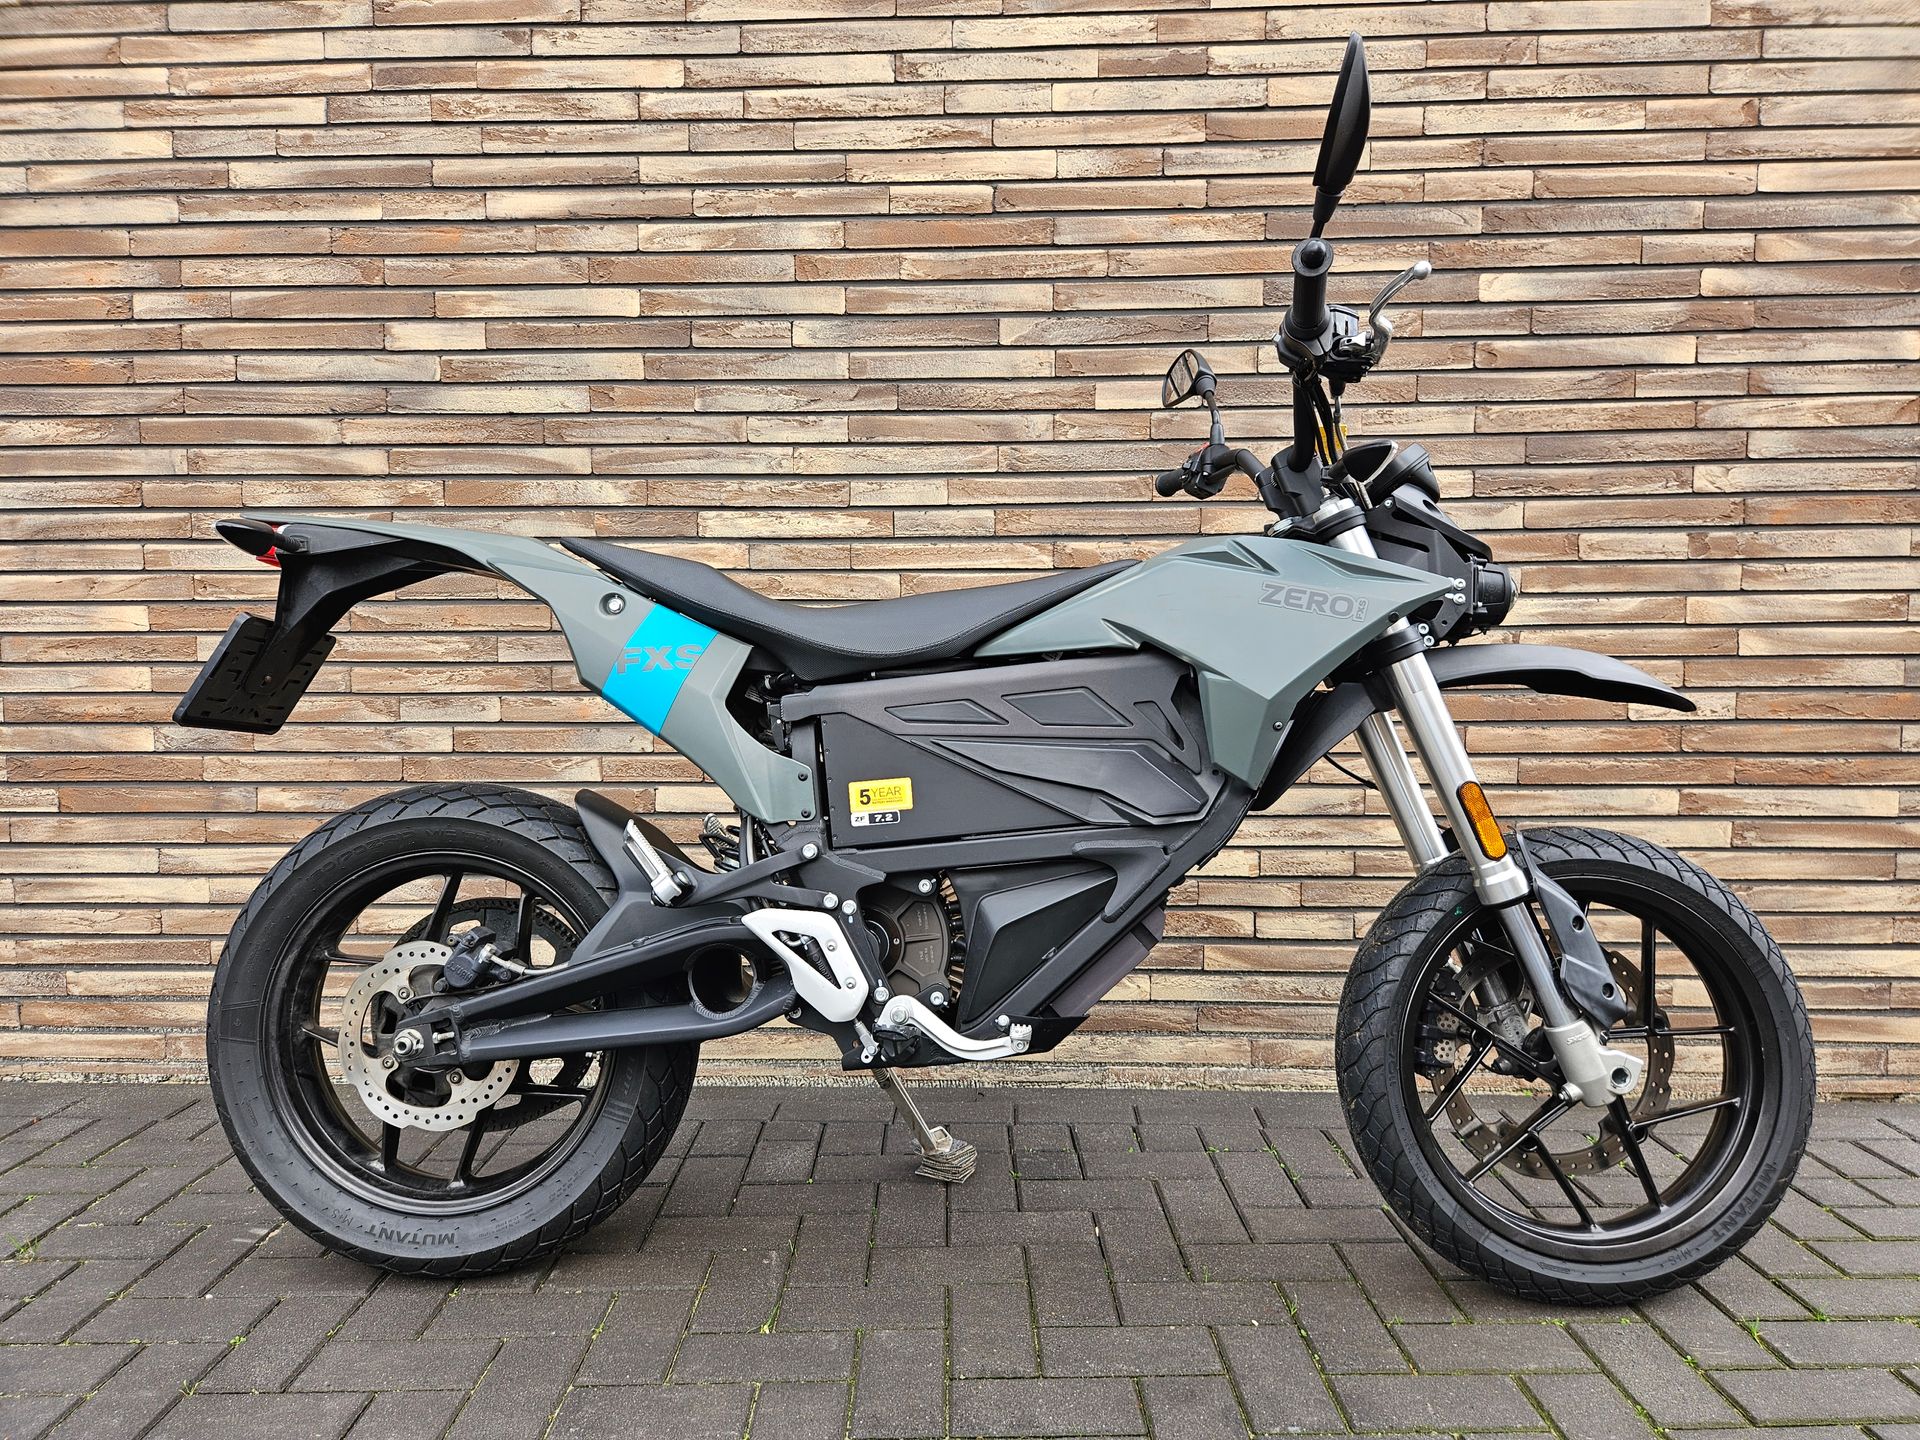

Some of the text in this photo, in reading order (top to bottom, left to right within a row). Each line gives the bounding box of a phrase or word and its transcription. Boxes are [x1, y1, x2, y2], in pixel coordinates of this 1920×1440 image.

[1260, 583, 1354, 617] ZERO
[1355, 599, 1367, 619] FXS
[617, 644, 702, 674] FXS
[860, 788, 871, 805] 5
[871, 786, 902, 798] YEAR
[874, 813, 894, 823] 7.2
[1711, 1162, 1778, 1242] MUTANT
[364, 1224, 456, 1246] MUTANT
